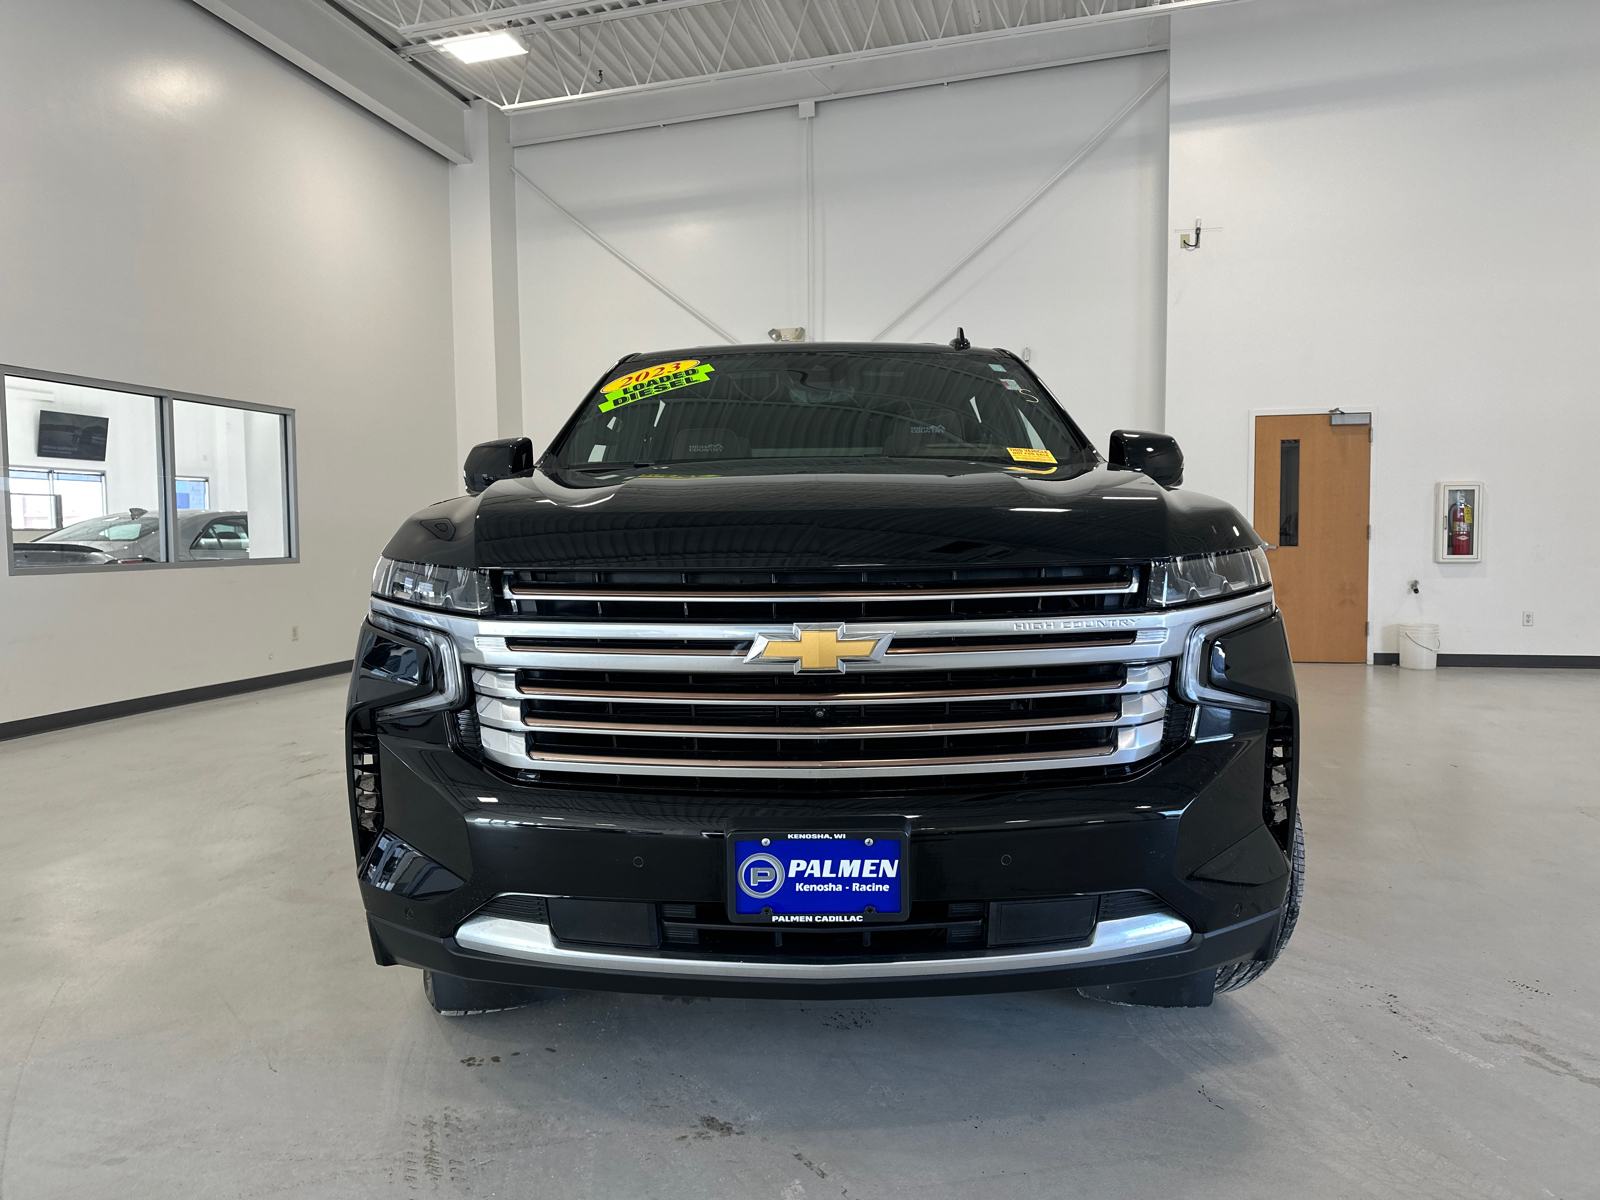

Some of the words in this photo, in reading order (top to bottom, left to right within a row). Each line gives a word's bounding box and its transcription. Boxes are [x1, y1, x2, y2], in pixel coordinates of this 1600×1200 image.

[619, 363, 681, 388] 2023
[622, 368, 699, 395] LOADED
[612, 377, 700, 406] DIESEL
[1013, 621, 1055, 631] HIGH
[1060, 618, 1140, 629] COUNTRY
[788, 859, 899, 878] PALMEN
[795, 882, 843, 892] Kenosha
[852, 882, 890, 892] Racine
